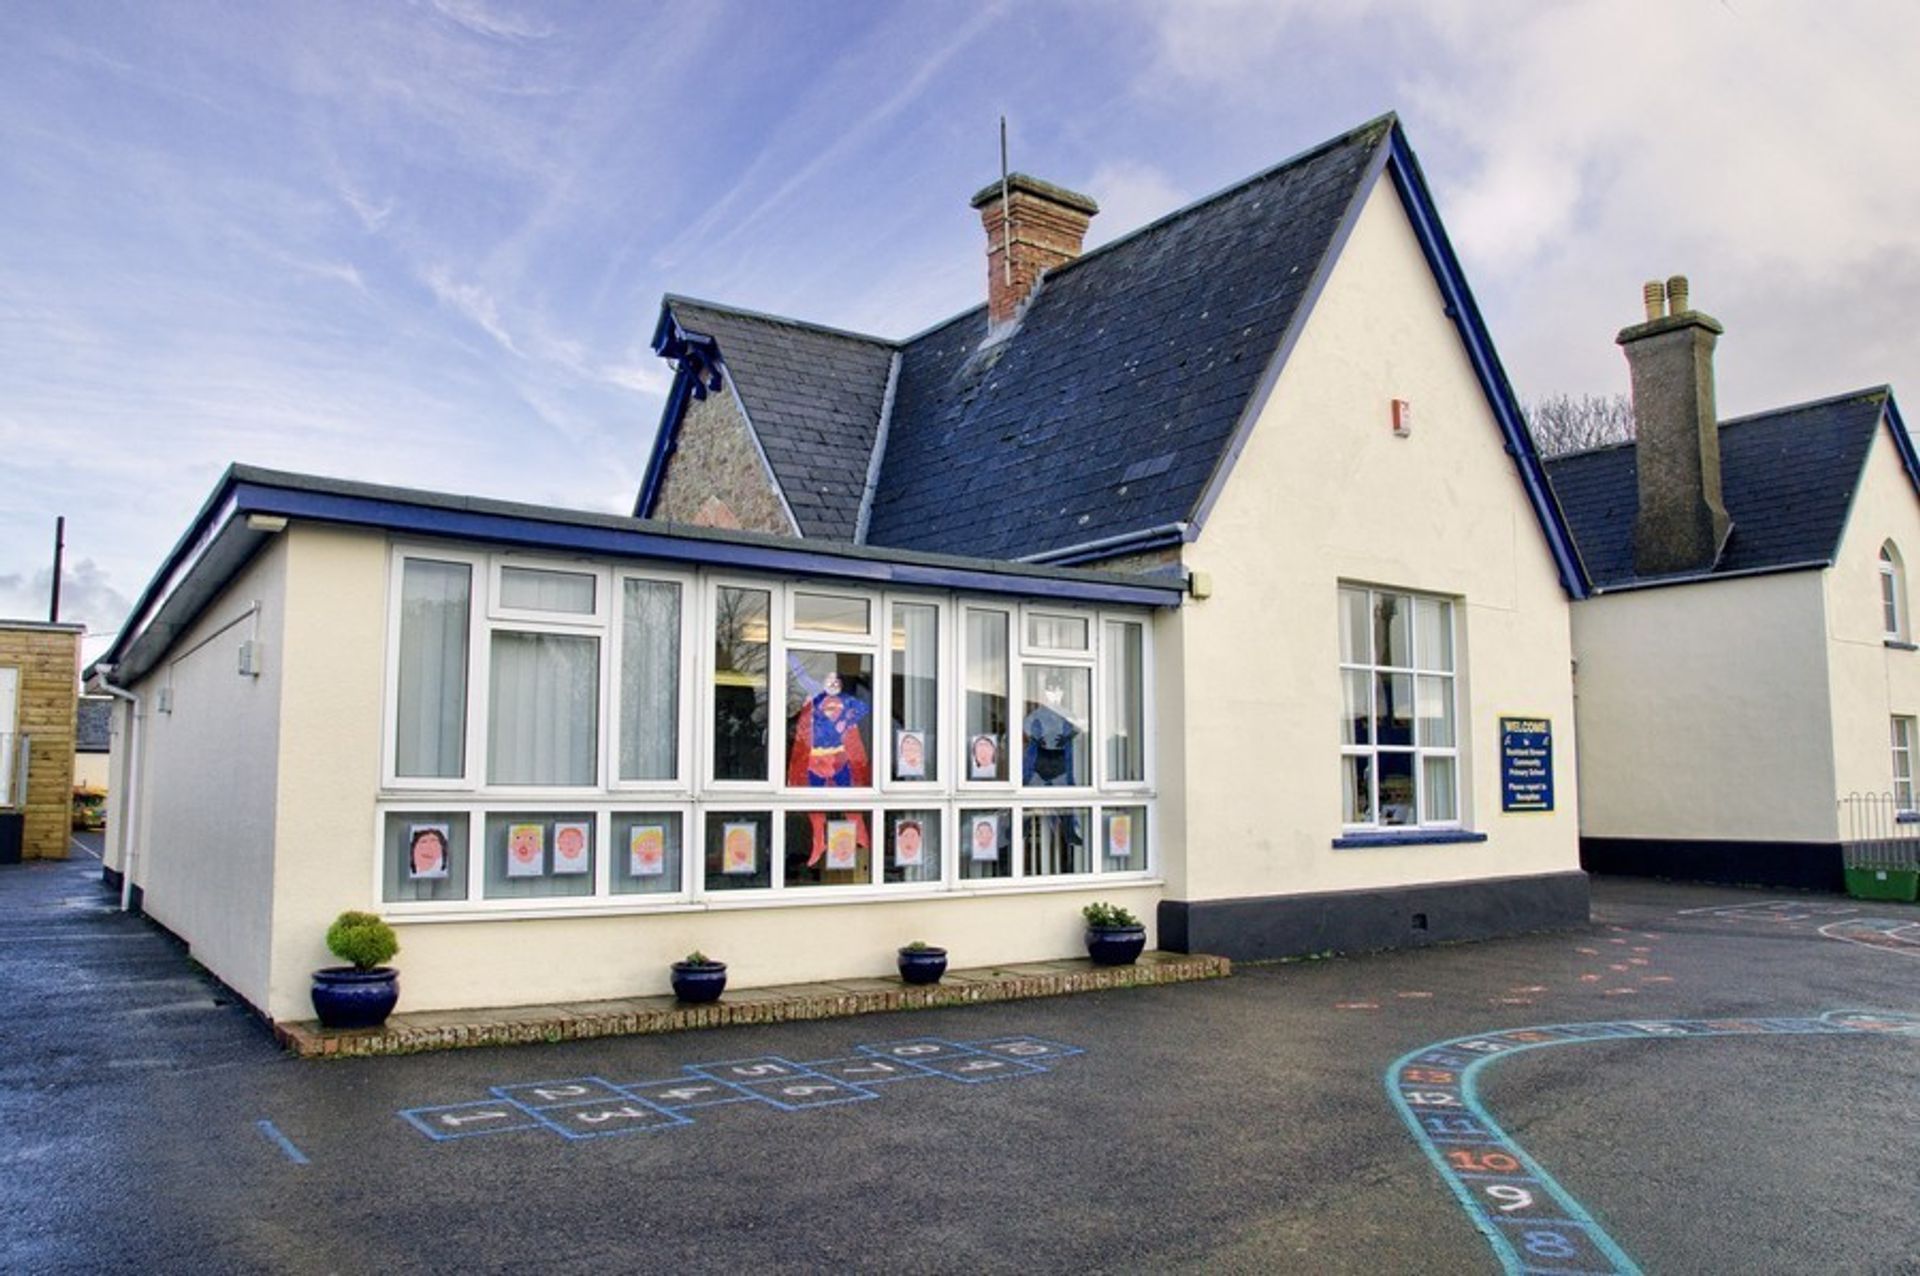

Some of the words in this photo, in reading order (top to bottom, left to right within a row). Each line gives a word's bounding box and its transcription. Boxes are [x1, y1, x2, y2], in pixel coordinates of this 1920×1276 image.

[1504, 721, 1547, 733] WELCOME
[731, 1064, 787, 1076] 5
[843, 1062, 894, 1072] 7
[533, 1086, 587, 1100] 2
[658, 1086, 712, 1099] 4
[783, 1085, 836, 1096] 6
[1404, 1092, 1463, 1106] 12
[441, 1111, 507, 1126] 1
[576, 1107, 644, 1122] 3
[1424, 1118, 1488, 1134] 11
[1448, 1151, 1521, 1172] 10
[1486, 1185, 1533, 1211] 9
[1523, 1230, 1577, 1258] 8
